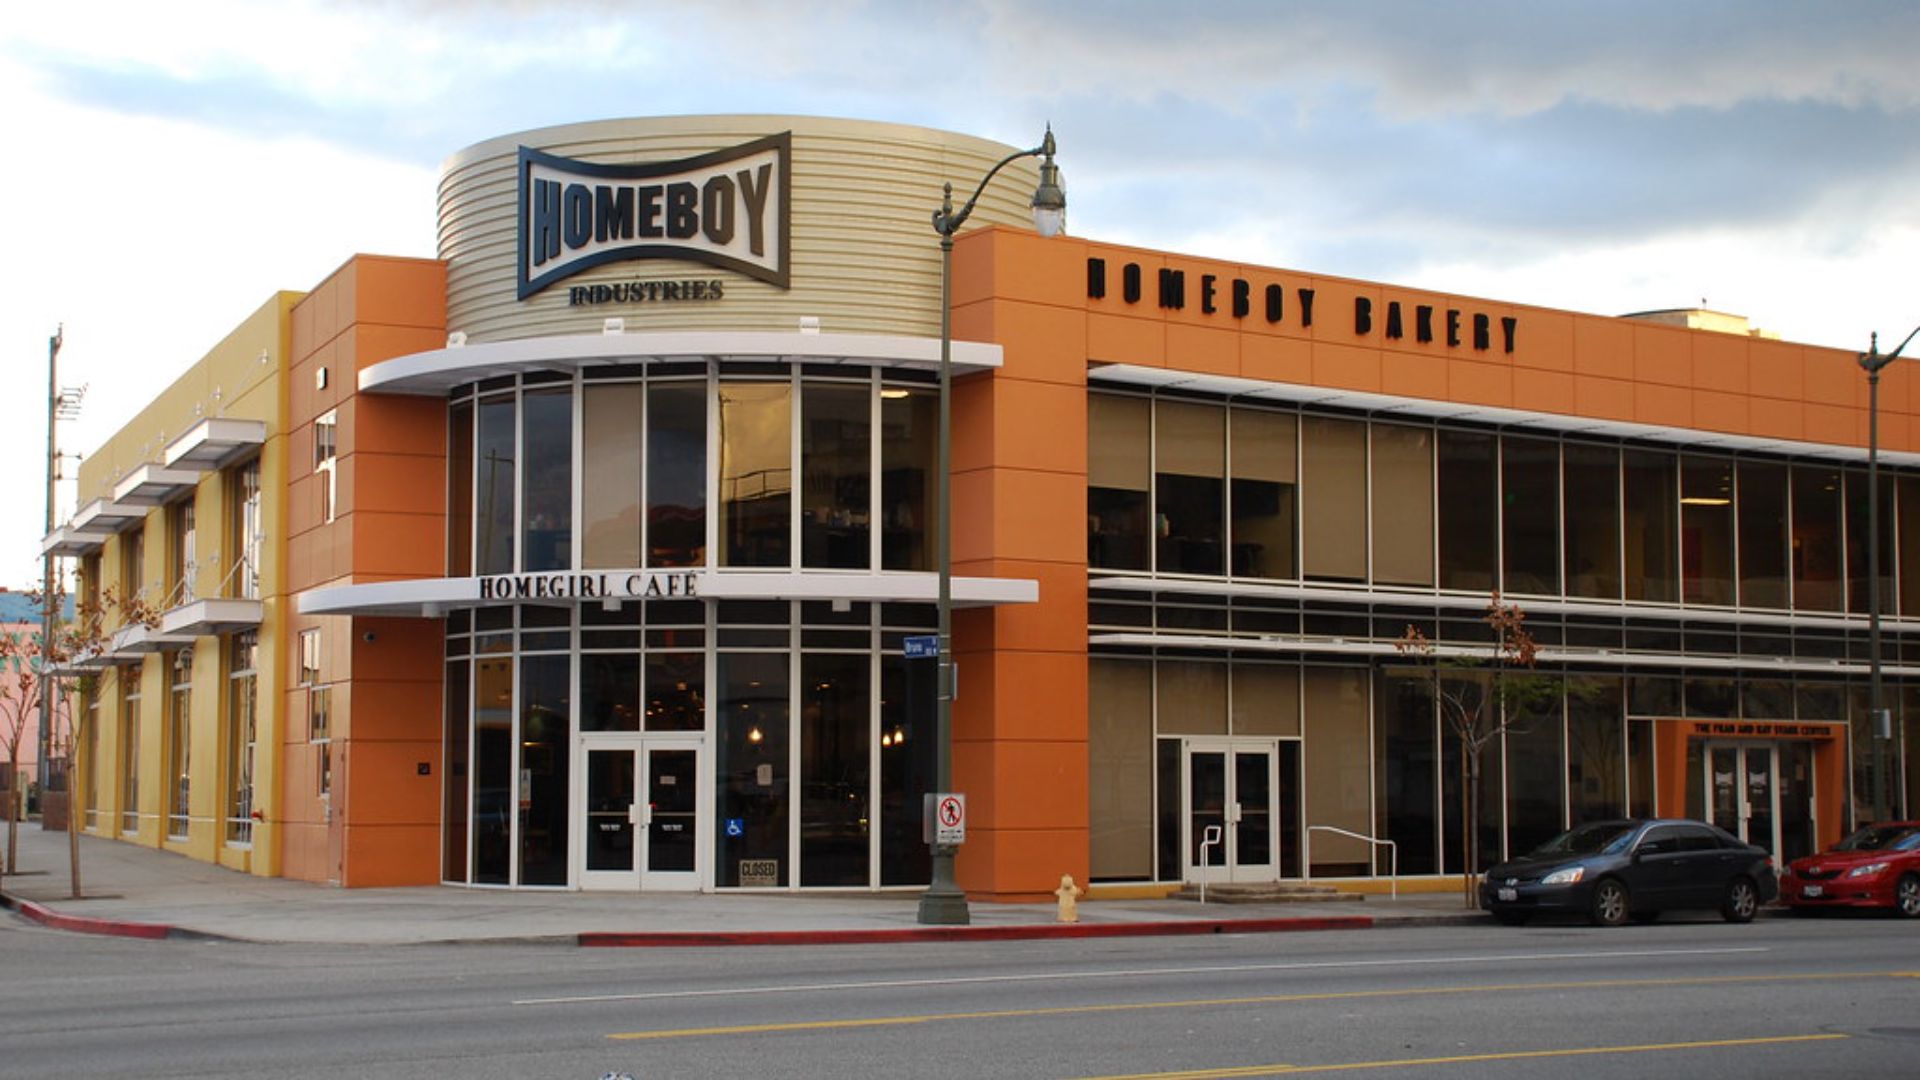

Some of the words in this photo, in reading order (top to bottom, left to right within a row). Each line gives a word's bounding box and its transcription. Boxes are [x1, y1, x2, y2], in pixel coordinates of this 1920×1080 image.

[534, 163, 772, 266] HOMEBOY
[569, 281, 724, 306] INDUSTRIES
[1087, 257, 1315, 328] HOMEBOY
[1355, 296, 1518, 354] BAKERY
[480, 573, 612, 599] HOMEGIRL
[625, 570, 698, 597] CAFÉ
[742, 862, 776, 876] CLOSED
